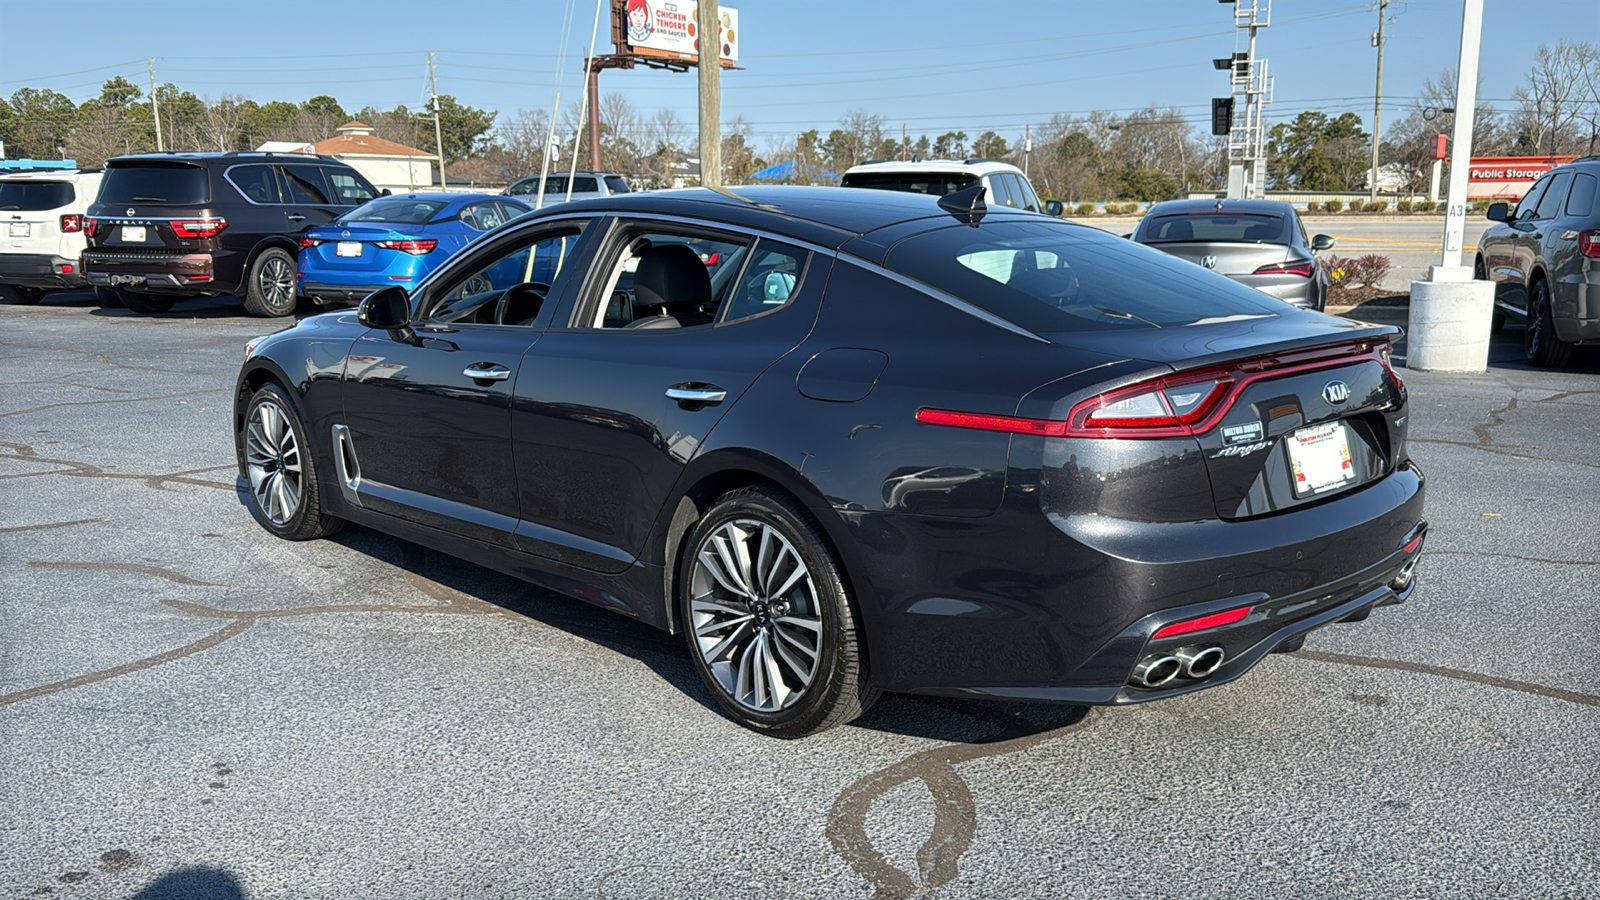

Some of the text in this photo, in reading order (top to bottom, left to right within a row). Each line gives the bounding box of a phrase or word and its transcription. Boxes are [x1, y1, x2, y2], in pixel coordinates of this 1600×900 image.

[656, 9, 686, 21] CHICKEN
[656, 18, 686, 30] TENDERS
[656, 27, 686, 38] AND SAUCES
[1472, 169, 1547, 180] Public Storage
[1449, 204, 1464, 217] A3
[1327, 384, 1348, 402] KIA
[1223, 426, 1243, 437] MILTON
[757, 604, 765, 622] KIA
